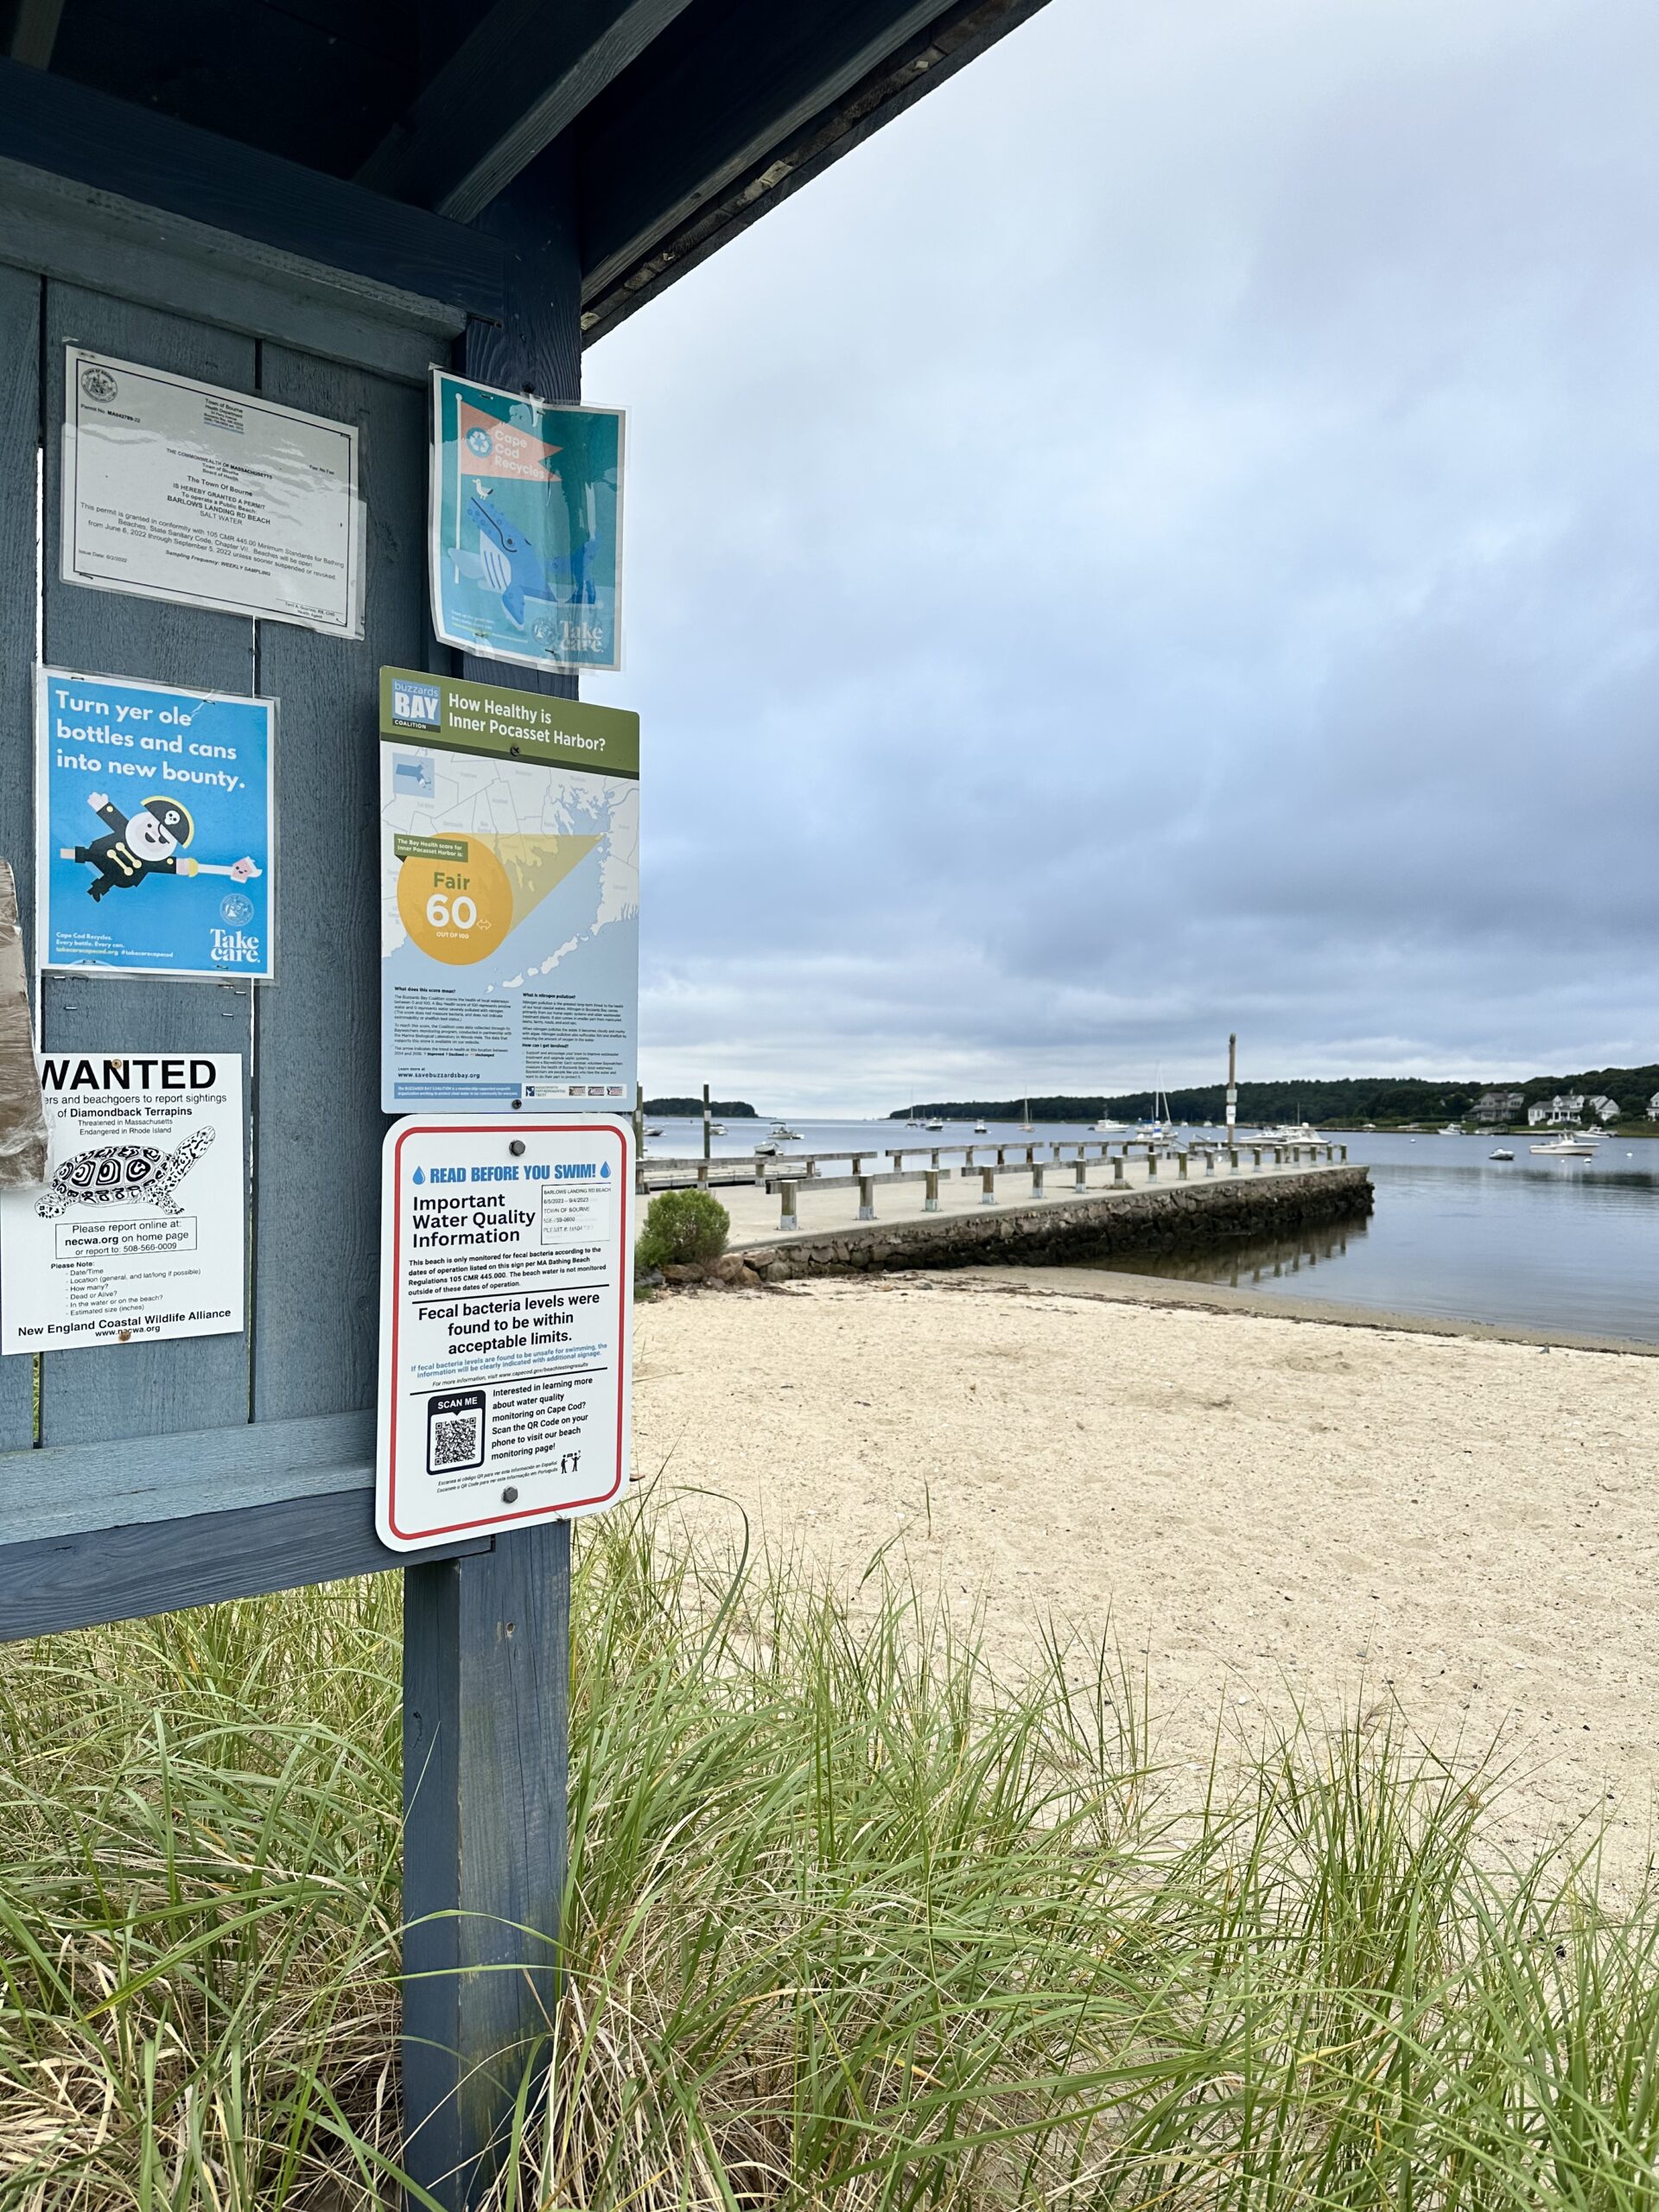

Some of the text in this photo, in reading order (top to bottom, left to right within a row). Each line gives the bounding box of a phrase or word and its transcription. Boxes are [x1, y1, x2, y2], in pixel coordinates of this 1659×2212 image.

[493, 429, 527, 448] Cape
[493, 443, 520, 460] Cod
[493, 455, 545, 480] Recycles
[187, 474, 200, 484] The
[200, 478, 219, 488] Town
[229, 486, 253, 497] Bourne
[180, 484, 207, 494] HEREBY
[207, 491, 237, 503] GRANTED
[243, 499, 265, 510] PERMIT
[167, 494, 203, 509] BARLOWS
[204, 503, 235, 516] LANDING
[247, 513, 270, 524] BEACH
[200, 510, 243, 525] SALT WATER
[559, 620, 604, 640] Take
[559, 638, 605, 653] care.
[394, 680, 439, 698] buzzards
[54, 690, 194, 726] Turn yer ole
[394, 691, 438, 720] BAY
[448, 692, 551, 724] How Healthy is
[394, 719, 426, 729] COALITION
[448, 711, 606, 752] Inner Pocasset Harbor?
[56, 719, 237, 760] bottles and cans
[56, 749, 245, 792] into new bounty.
[412, 846, 437, 855] Pocasset
[433, 871, 470, 890] Fair
[426, 893, 477, 929] 60
[209, 928, 260, 950] Take
[210, 946, 261, 963] care.
[41, 1058, 216, 1090] WANTED
[60, 1094, 80, 1104] and
[83, 1094, 140, 1106] beachgoers
[143, 1094, 152, 1103] to
[155, 1094, 183, 1104] report
[185, 1093, 227, 1104] sightings
[57, 1106, 193, 1118] of Diamondback Terrapins
[79, 1127, 119, 1136] Endangered
[429, 1163, 596, 1184] READ BEFORE YOU SWIM!
[413, 1193, 505, 1213] Important
[72, 1219, 182, 1233] Please report online at:
[412, 1214, 468, 1230] Water
[472, 1209, 536, 1229] Quality
[65, 1236, 118, 1246] necwa.org
[165, 1232, 188, 1242] page
[413, 1227, 519, 1248] Information
[86, 1247, 109, 1255] report
[123, 1242, 177, 1253] 508-566-0009
[468, 1253, 501, 1262] monitored
[418, 1294, 600, 1320] Fecal bacteria levels were
[18, 1310, 231, 1336] New England Coastal Wildlife Alliance
[447, 1311, 573, 1336] found to be within
[448, 1330, 572, 1355] acceptable limits.
[493, 1383, 531, 1397] Interested
[542, 1379, 572, 1389] learning
[574, 1377, 593, 1386] more
[437, 1396, 478, 1409] SCAN ME
[492, 1393, 564, 1409] about water quality
[492, 1409, 534, 1422] monitoring
[546, 1405, 566, 1414] Cape
[567, 1401, 586, 1411] Cod?
[492, 1426, 512, 1434] Scan
[512, 1423, 525, 1432] the
[526, 1421, 538, 1430] QR
[539, 1417, 559, 1427] Code
[571, 1414, 588, 1424] your
[491, 1438, 516, 1449] phone
[526, 1432, 543, 1441] visit
[558, 1426, 581, 1437] beach
[491, 1442, 556, 1460] monitoring page!
